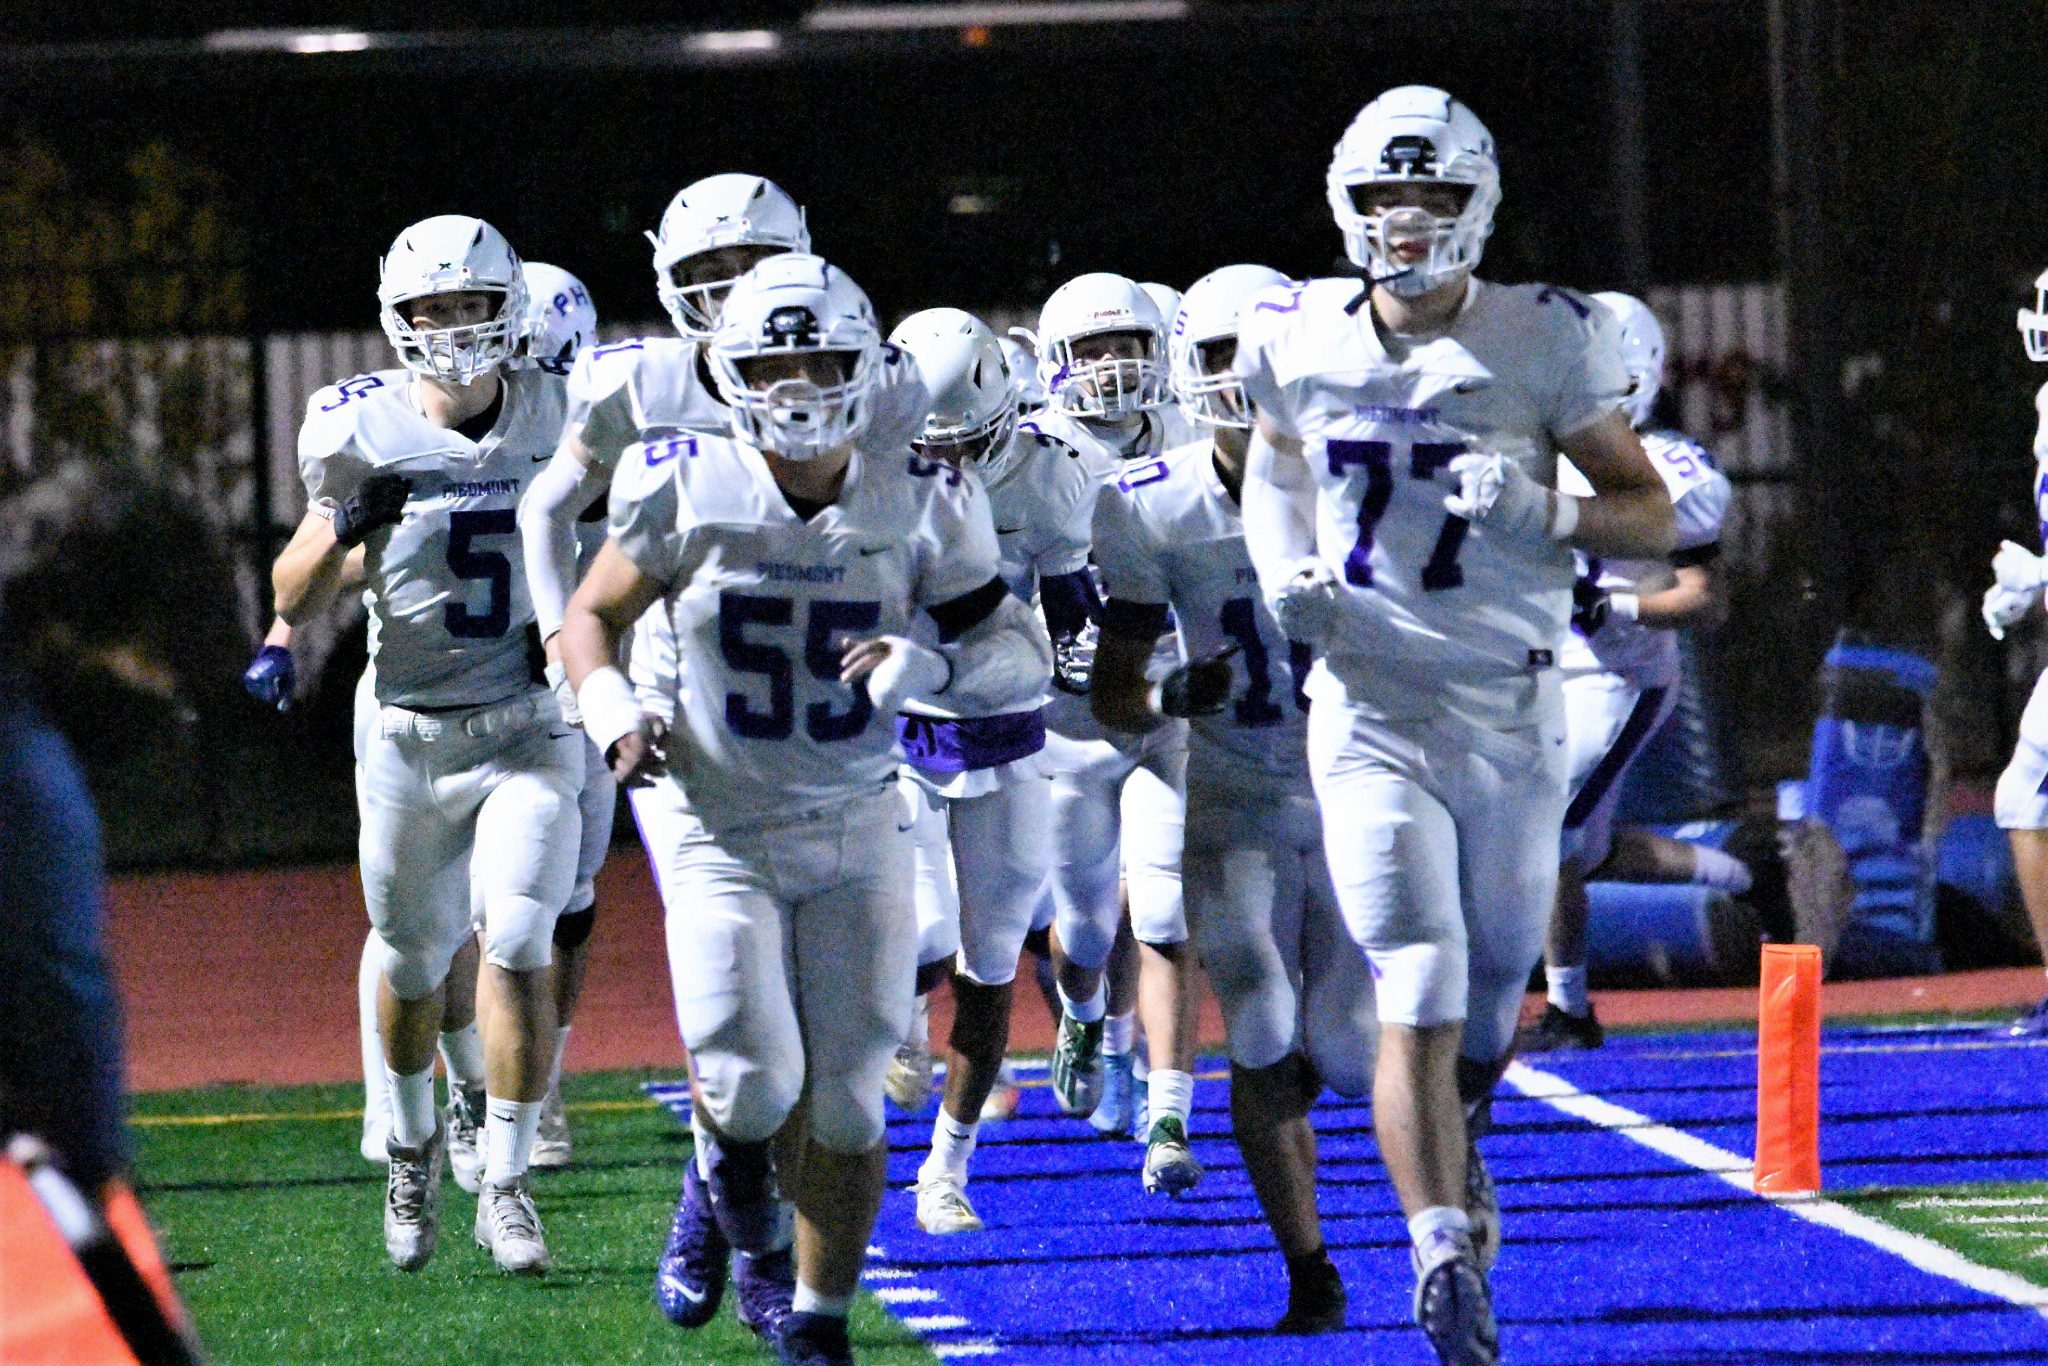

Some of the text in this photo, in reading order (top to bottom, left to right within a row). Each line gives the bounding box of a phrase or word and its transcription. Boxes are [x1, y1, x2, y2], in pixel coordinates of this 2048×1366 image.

[444, 508, 517, 639] 5
[1326, 439, 1472, 592] 77
[720, 588, 882, 743] 55
